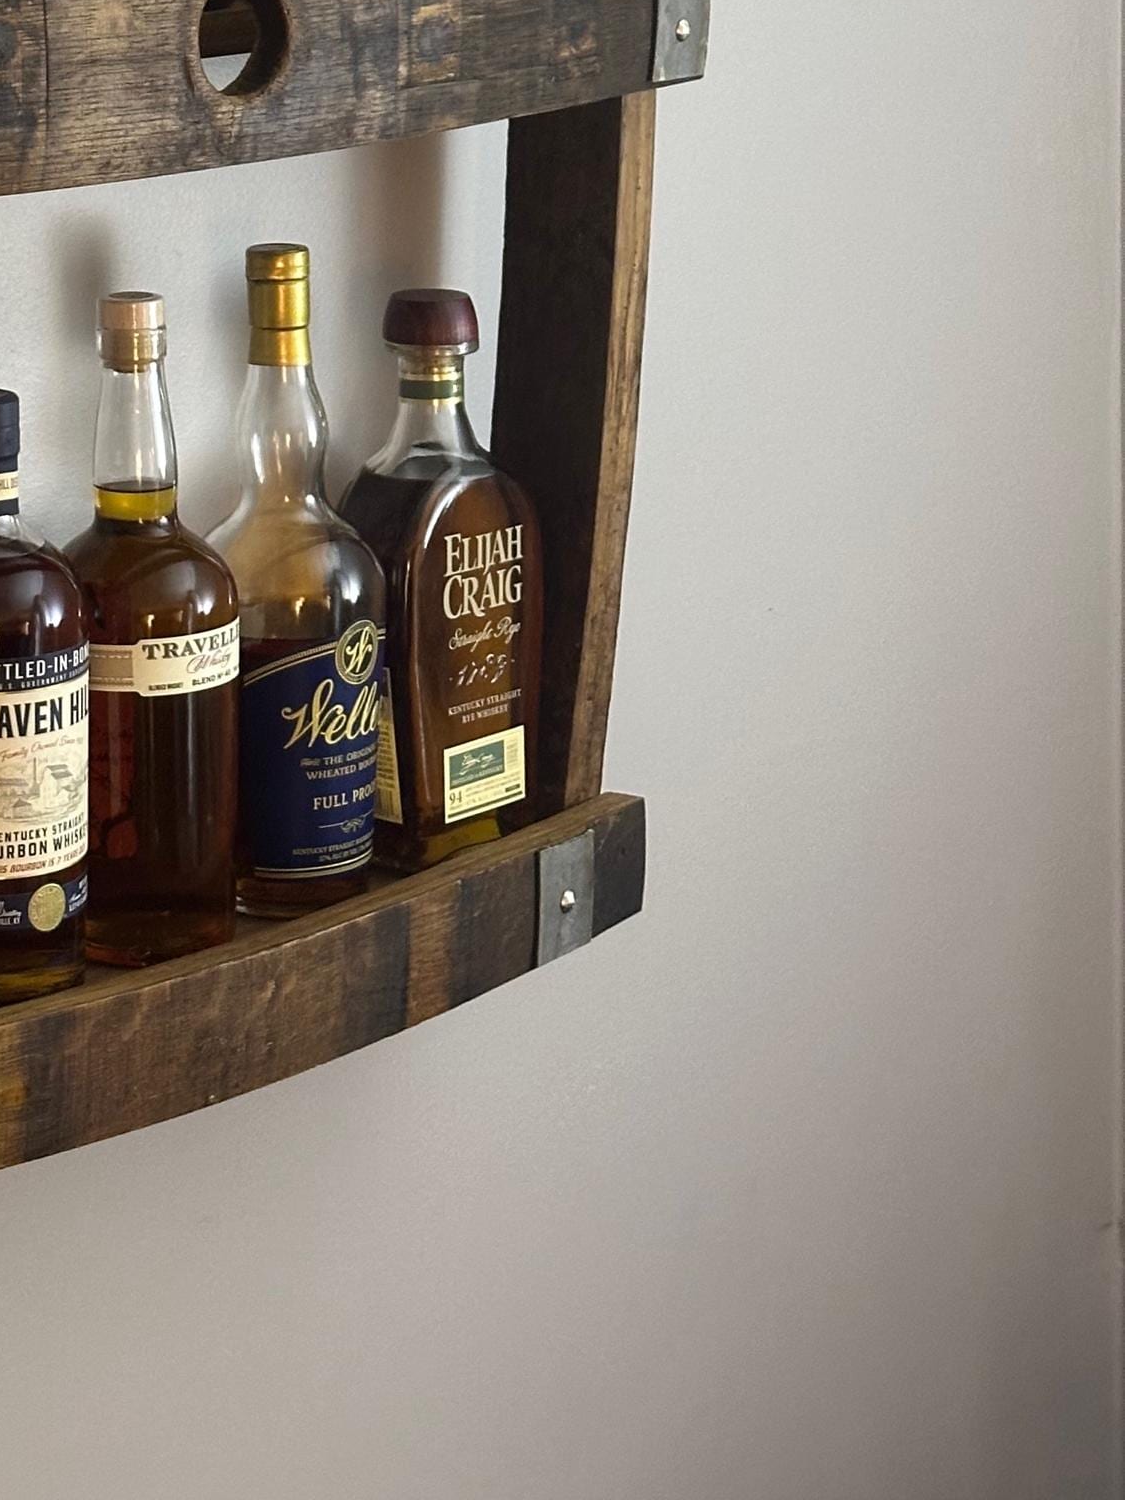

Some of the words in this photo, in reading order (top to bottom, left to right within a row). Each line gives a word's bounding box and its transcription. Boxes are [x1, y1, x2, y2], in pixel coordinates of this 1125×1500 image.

[443, 524, 524, 578] ELIJAH
[443, 565, 523, 619] CRAIG
[449, 620, 492, 652] Straight
[493, 616, 522, 644] Rye
[192, 675, 216, 686] BLEND
[448, 697, 486, 717] KENTUCKY
[486, 688, 523, 707] STRAIGHT
[461, 712, 476, 724] RYE
[477, 703, 509, 720] WHISKEY
[322, 755, 344, 766] THE
[306, 764, 357, 781] WHEATED
[313, 792, 348, 811] FULL
[10, 860, 46, 874] BOURBON
